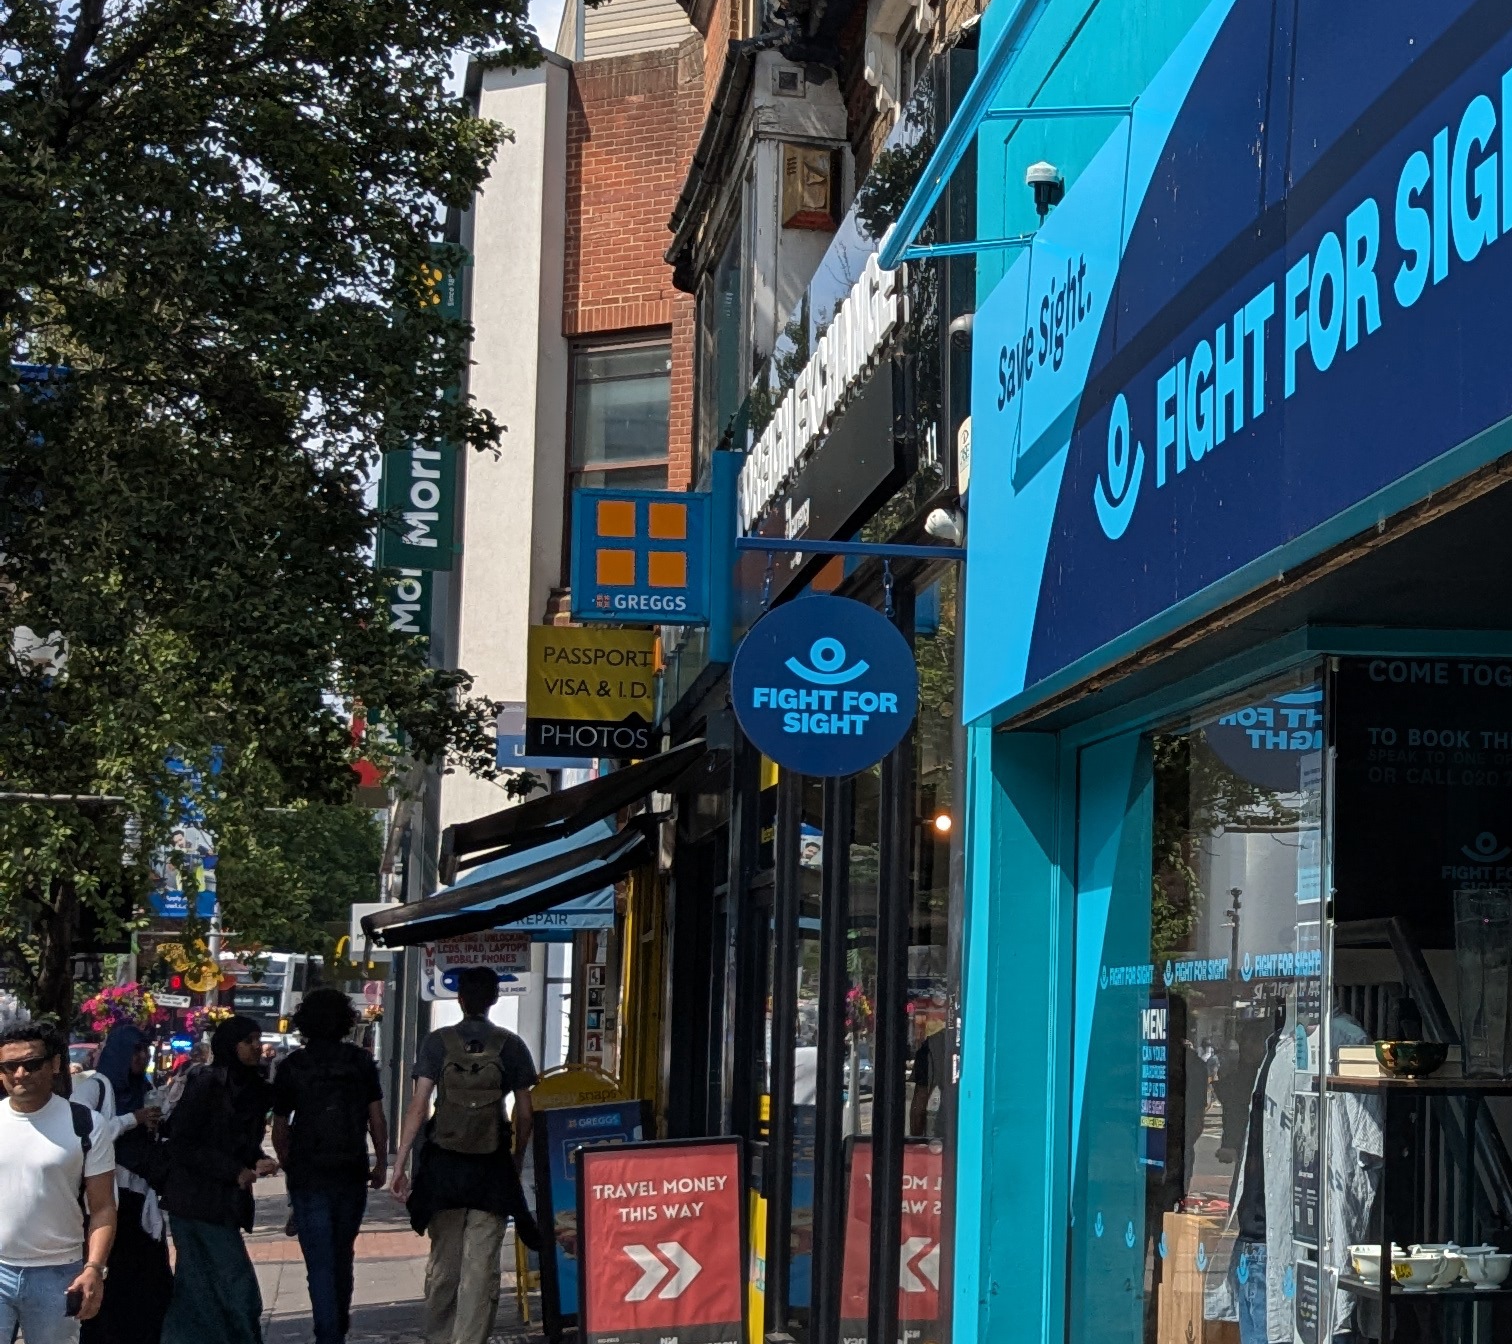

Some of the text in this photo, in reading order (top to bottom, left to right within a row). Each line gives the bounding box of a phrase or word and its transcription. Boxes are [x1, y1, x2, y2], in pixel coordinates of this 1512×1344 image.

[997, 252, 1093, 413] Save Sight.
[1156, 281, 1275, 489] FIGHT
[1284, 197, 1382, 399] FOR
[614, 594, 687, 611] GREGGS
[543, 646, 654, 667] PASSPORT
[1368, 659, 1449, 684] COME
[544, 678, 591, 697] VISA
[596, 680, 611, 698] &
[753, 687, 898, 714] FIGHT FOR
[783, 712, 870, 735] SIGHT
[541, 724, 648, 749] PHOTOS
[1367, 727, 1397, 746] TO
[1408, 728, 1471, 748] BOOK
[1368, 767, 1397, 784] OR
[1407, 768, 1458, 785] CALL
[1441, 865, 1492, 880] FIGHT
[489, 943, 528, 953] LAPTOPS
[446, 954, 517, 964] MOBILE PHONES
[1254, 954, 1277, 978] FIGHT
[1278, 952, 1293, 977] FOR
[1174, 958, 1229, 983] FIGHT FOR SIGHT
[1141, 1008, 1167, 1040] MEN!
[578, 1088, 617, 1102] snaps
[578, 1115, 618, 1127] GREGGS
[592, 1175, 728, 1200] TRAVEL MONEY
[618, 1202, 704, 1223] THIS WAY
